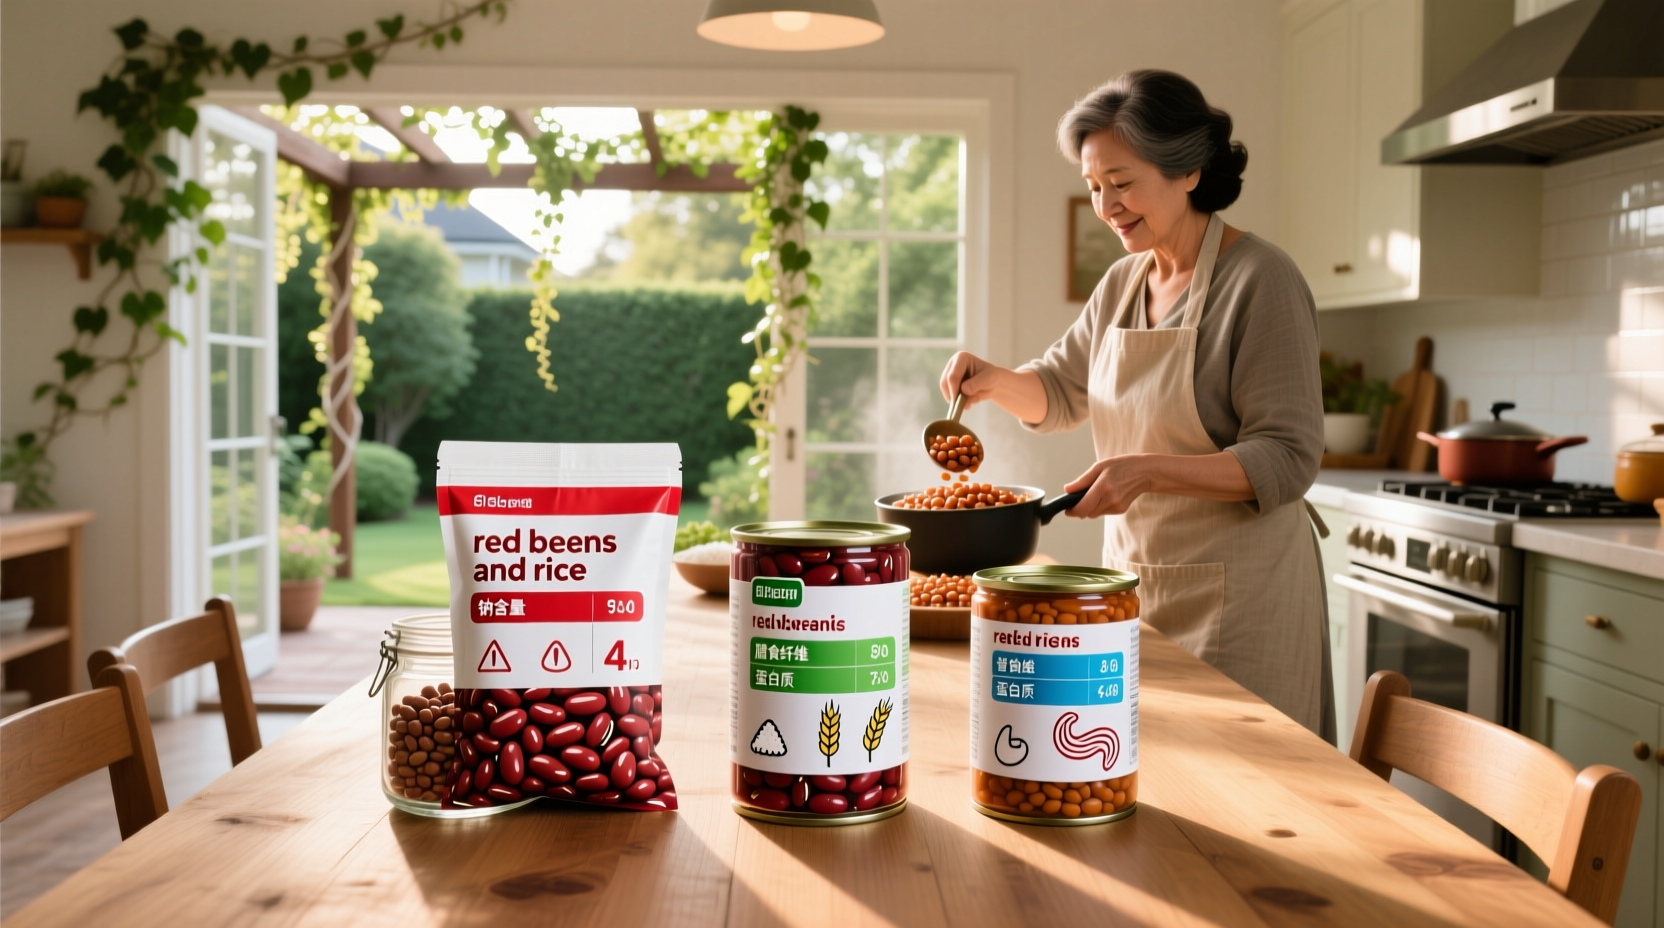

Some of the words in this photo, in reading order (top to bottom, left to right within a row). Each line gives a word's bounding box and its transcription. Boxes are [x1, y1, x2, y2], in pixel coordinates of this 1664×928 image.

[474, 528, 521, 553] red
[529, 528, 617, 553] beens
[474, 557, 526, 581] and
[534, 557, 587, 581] rice
